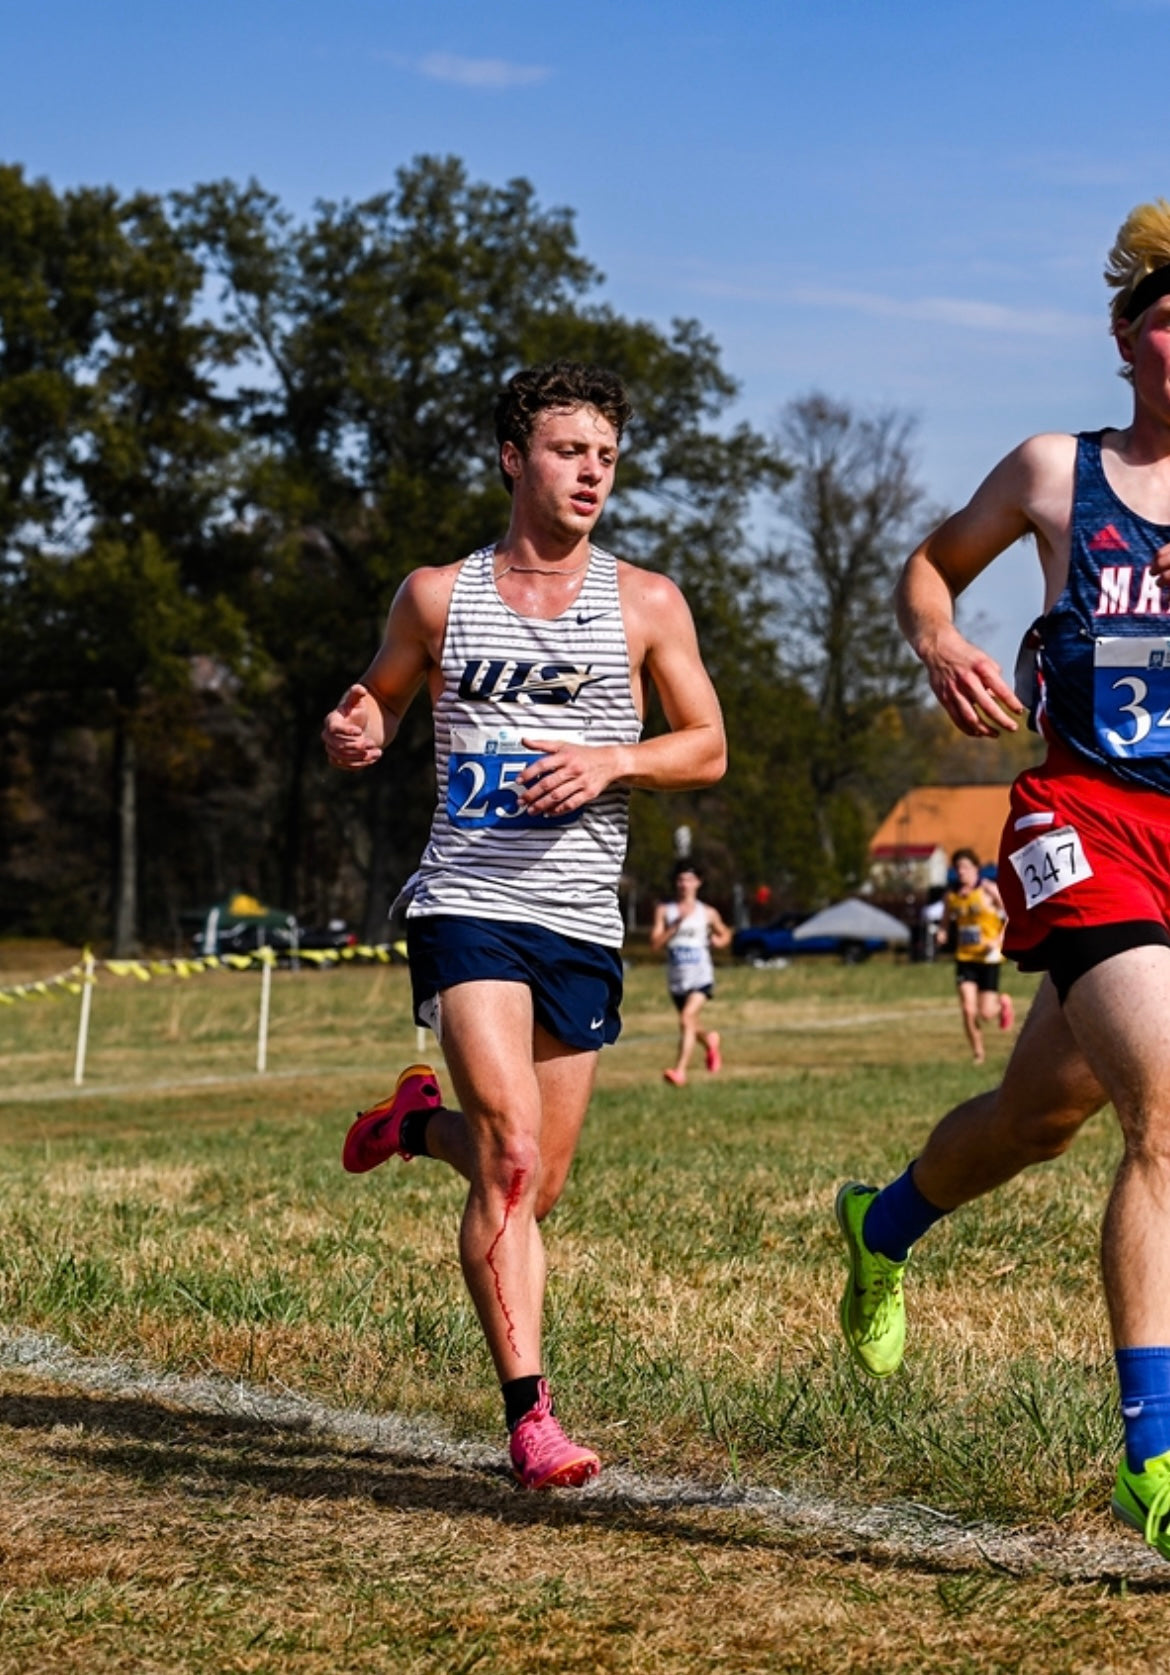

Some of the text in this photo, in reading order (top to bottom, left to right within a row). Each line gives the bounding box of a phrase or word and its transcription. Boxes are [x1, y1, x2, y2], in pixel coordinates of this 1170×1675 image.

[1094, 565, 1170, 616] MA
[1107, 676, 1170, 745] 3
[456, 761, 549, 818] 25
[1024, 842, 1076, 899] 347
